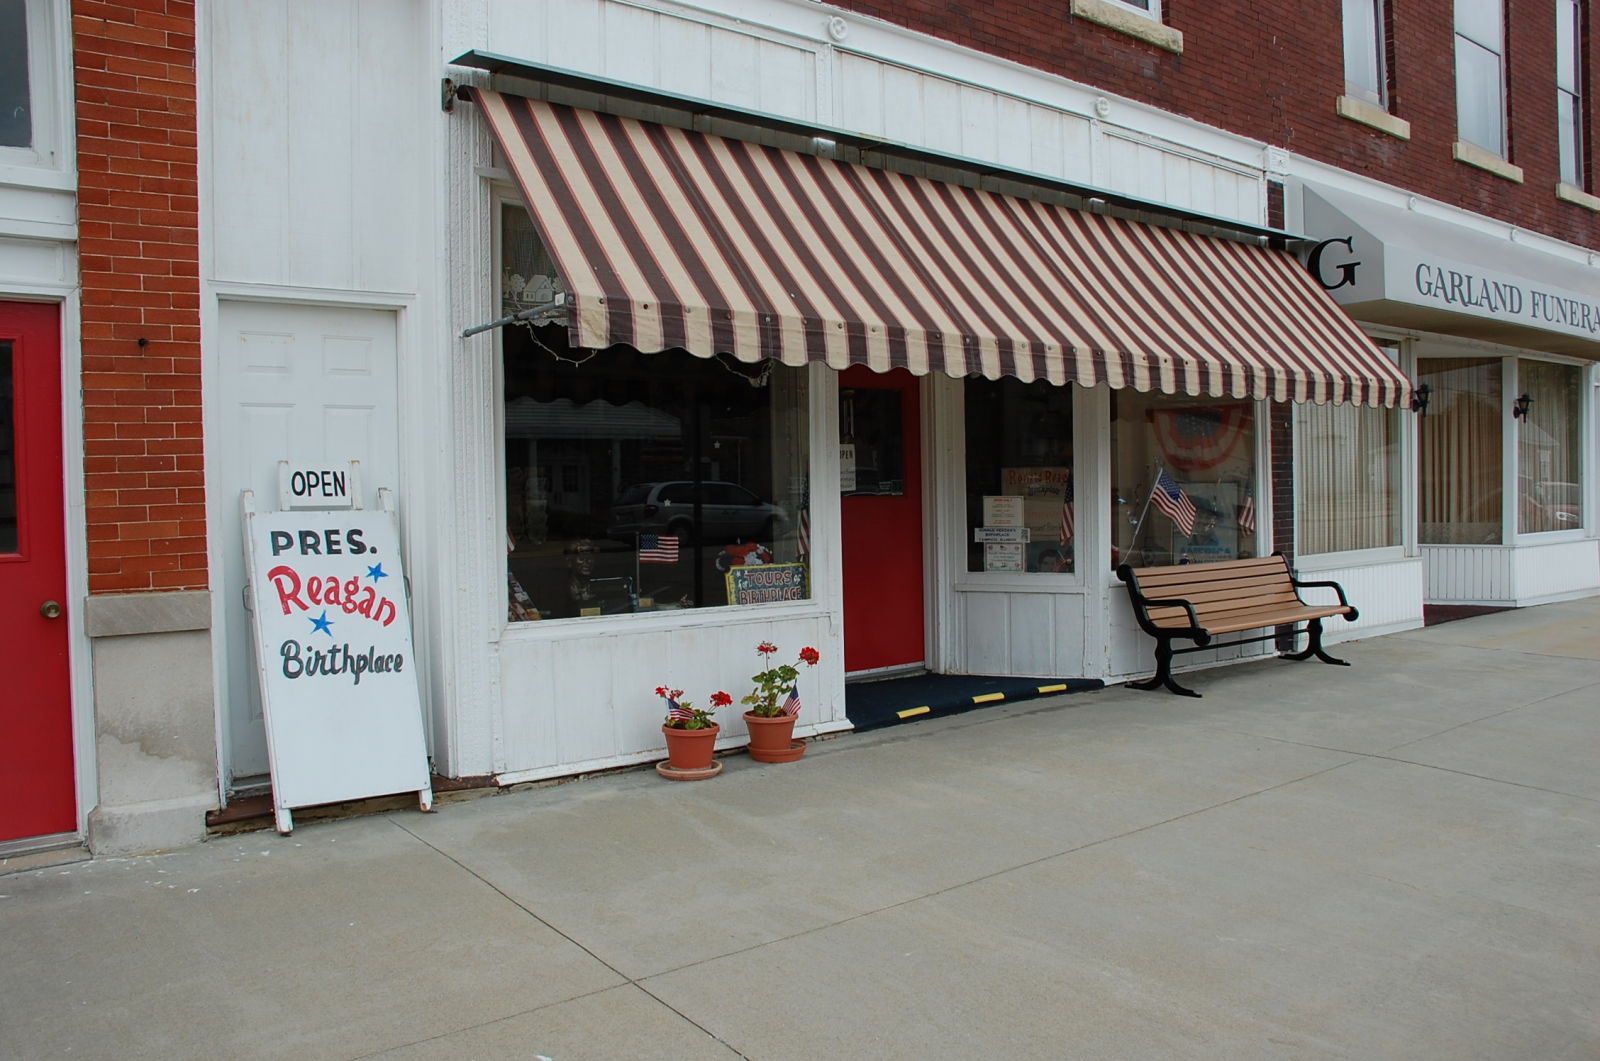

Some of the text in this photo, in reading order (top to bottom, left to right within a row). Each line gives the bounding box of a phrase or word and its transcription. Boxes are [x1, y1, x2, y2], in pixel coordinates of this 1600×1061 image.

[1307, 236, 1361, 290] G
[1415, 263, 1600, 334] GARLAND FUNERA
[291, 470, 346, 497] OPEN
[270, 528, 378, 557] PRES.
[267, 565, 396, 627] Reagan
[740, 587, 801, 605] BIRTHPLACE
[745, 571, 791, 585] TOURS
[280, 639, 404, 685] Birthplace
